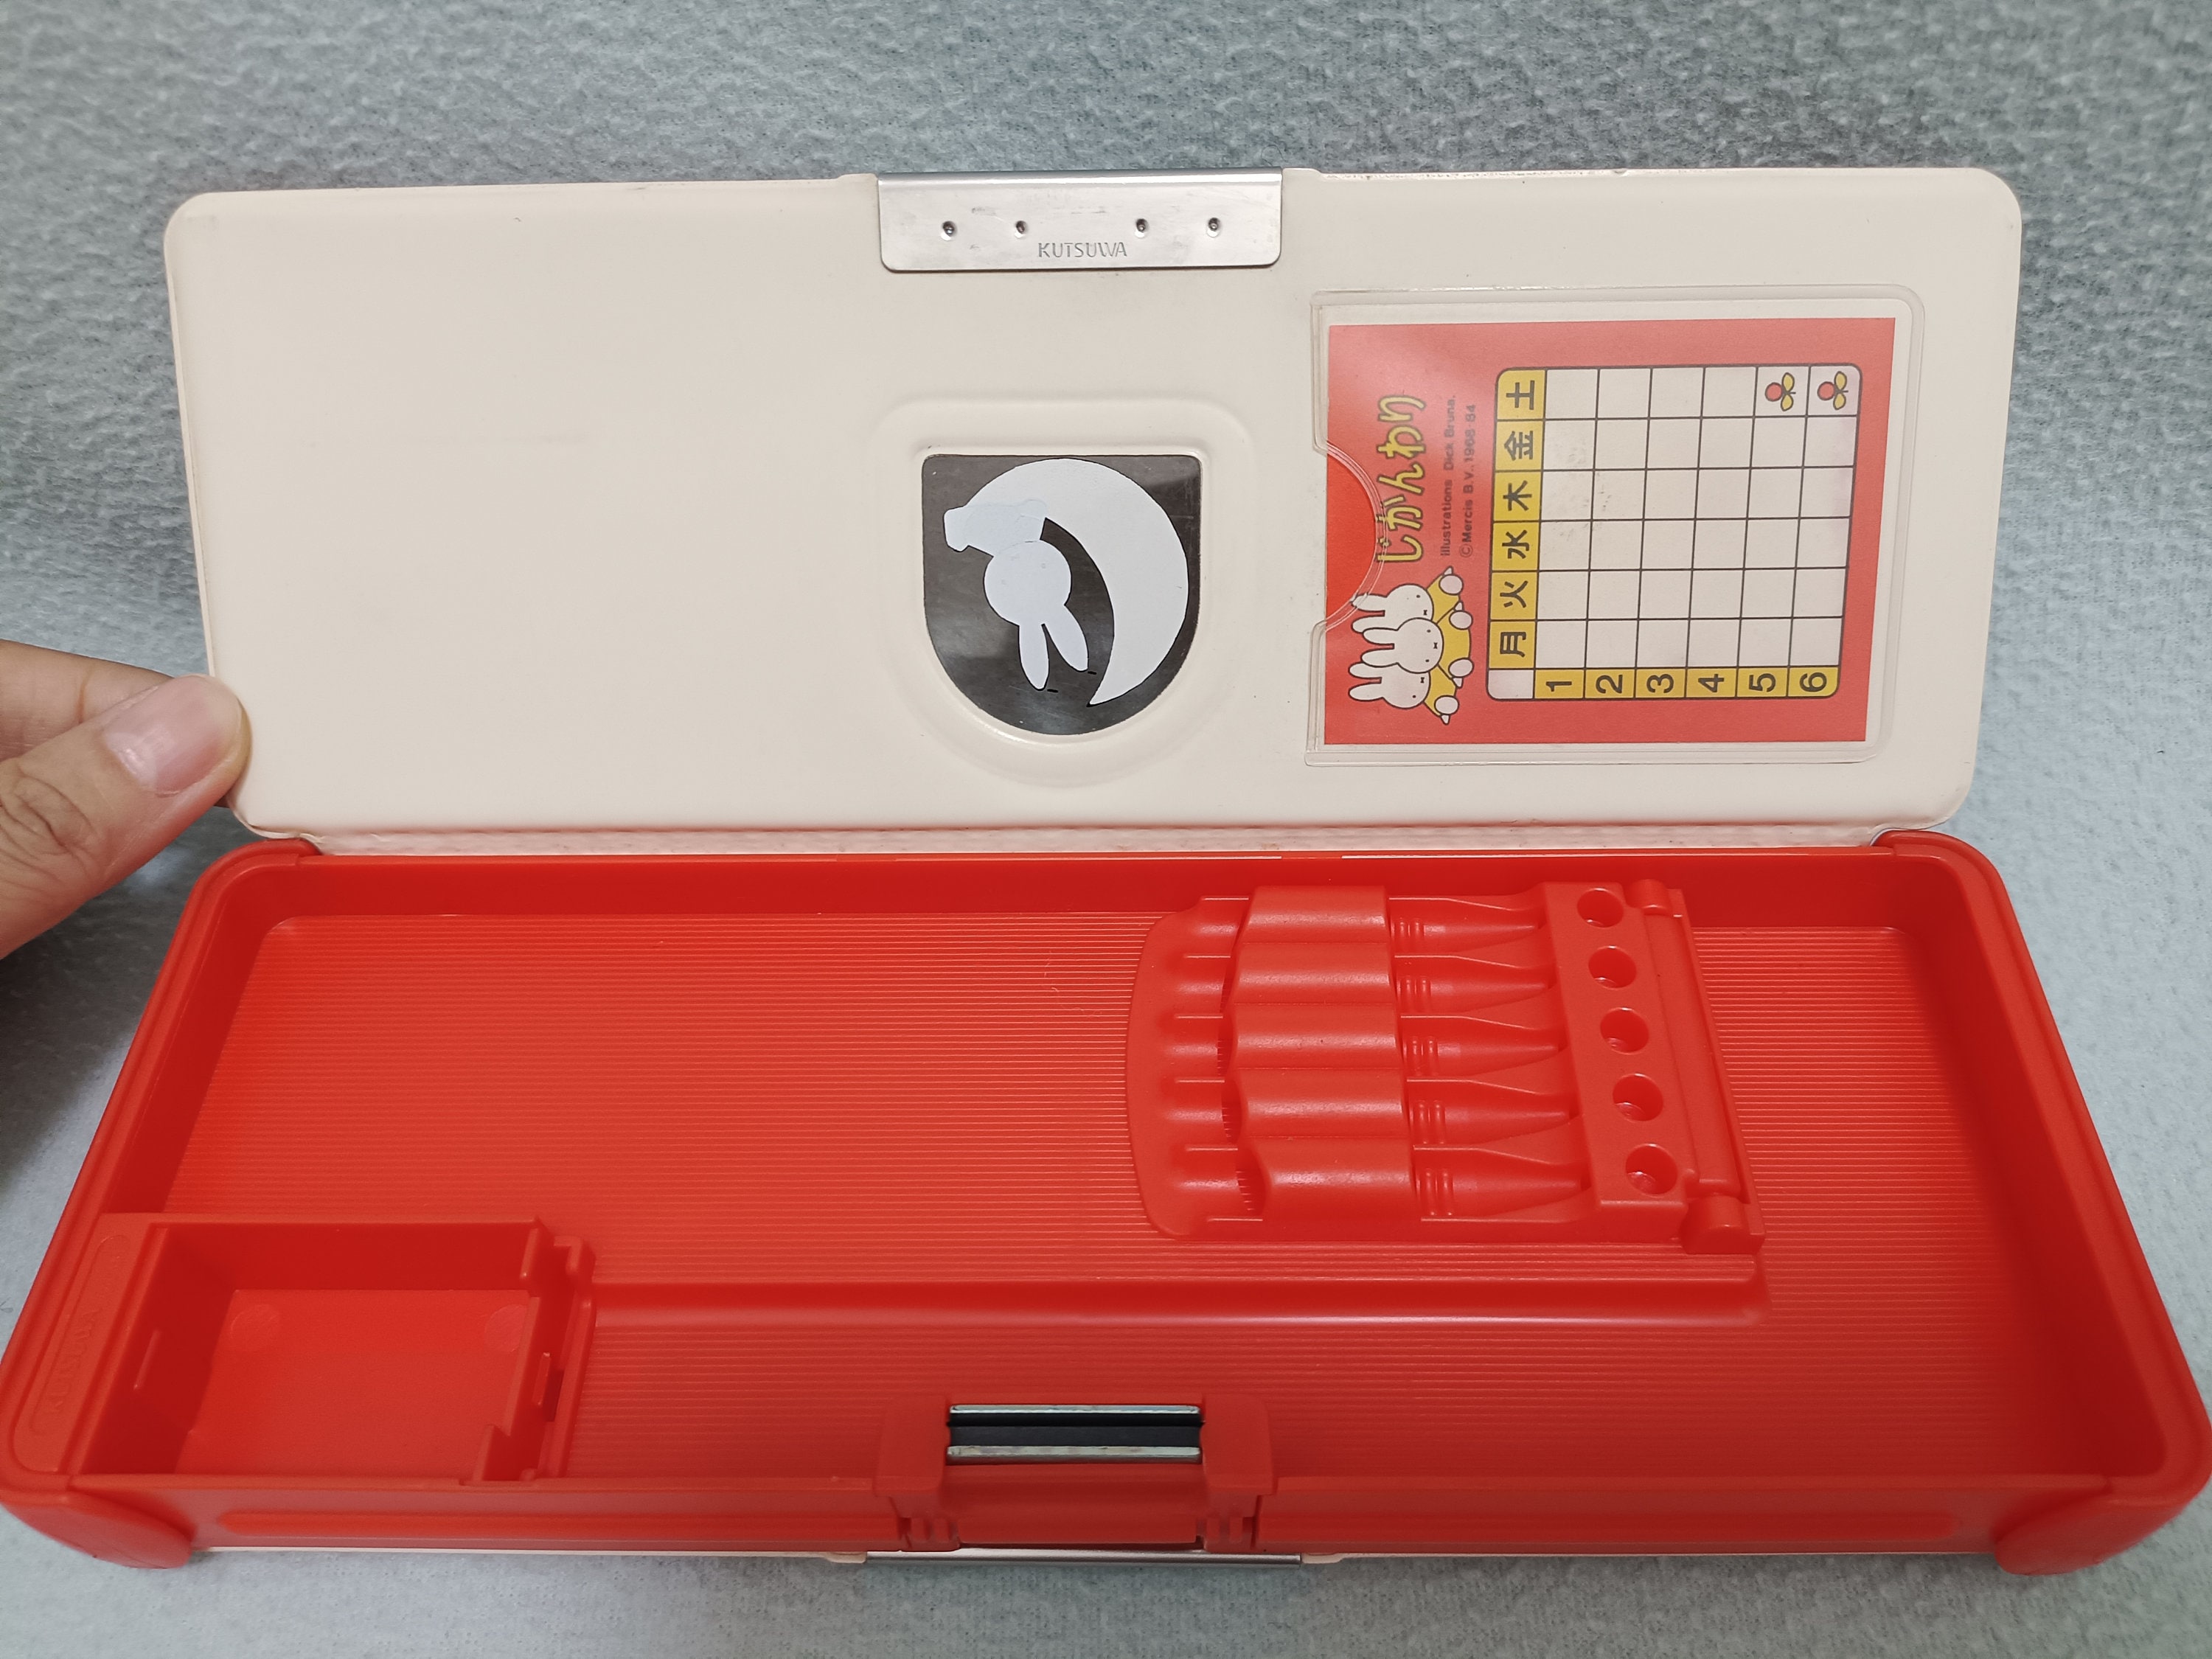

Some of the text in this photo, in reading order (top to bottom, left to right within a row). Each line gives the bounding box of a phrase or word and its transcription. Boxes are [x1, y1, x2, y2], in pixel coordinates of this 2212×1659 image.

[1038, 242, 1127, 258] KUTSUWA
[1377, 396, 1425, 562] じかんわり
[1499, 380, 1535, 658] 月 火 水 木 金 土
[1545, 680, 1573, 690] 1
[1596, 674, 1623, 695] 2
[1646, 674, 1674, 694] 3
[1697, 674, 1725, 693] 4
[1748, 672, 1776, 693] 5
[1799, 672, 1828, 693] 6
